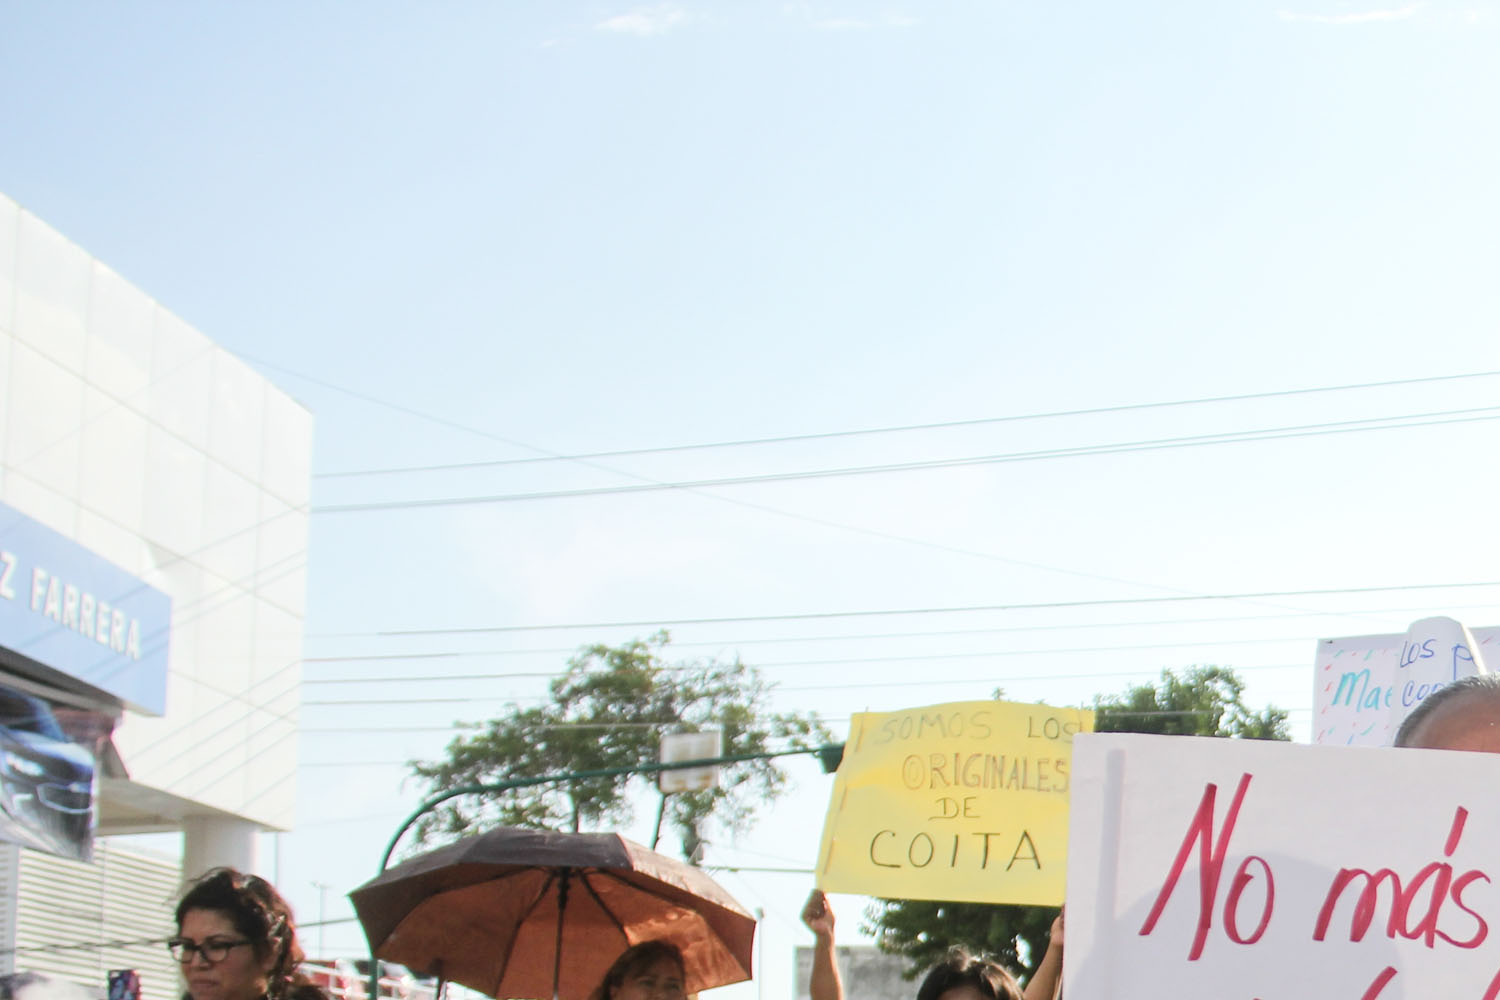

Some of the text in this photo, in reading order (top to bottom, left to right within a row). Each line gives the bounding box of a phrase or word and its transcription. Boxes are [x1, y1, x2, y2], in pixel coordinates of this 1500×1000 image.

[30, 567, 142, 661] FARRERA
[873, 710, 993, 745] SOMOS
[902, 752, 1070, 793] ORIGINALES
[928, 797, 982, 821] DE
[869, 829, 1041, 872] COITA
[1139, 773, 1277, 962] No
[1312, 807, 1491, 950] más
